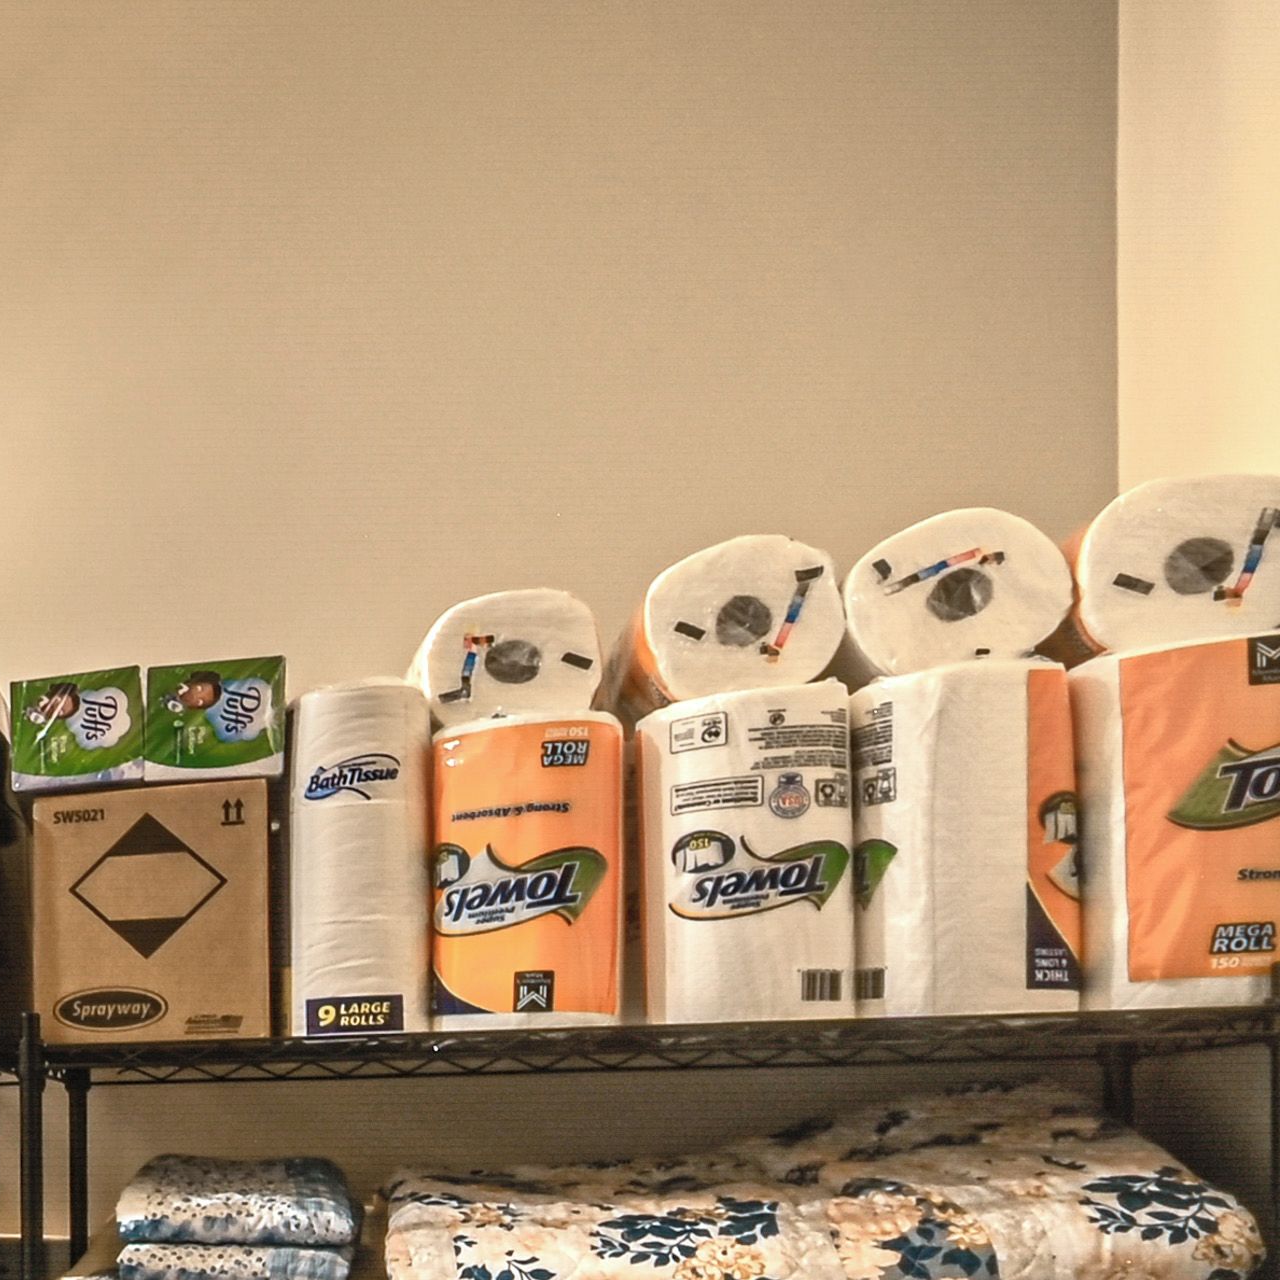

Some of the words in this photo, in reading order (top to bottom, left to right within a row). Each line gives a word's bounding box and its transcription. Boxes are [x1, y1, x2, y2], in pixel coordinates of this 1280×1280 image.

[220, 685, 261, 734] Puffs
[81, 695, 118, 741] Puffs
[543, 741, 588, 755] ROLL
[543, 753, 585, 766] MEGA
[527, 801, 571, 813] Strong
[53, 808, 106, 825] SW5021
[452, 808, 512, 822] Absorbent
[692, 855, 826, 908] Towels
[1237, 868, 1280, 881] Stron
[444, 861, 582, 923] Towels
[1216, 923, 1274, 938] MEGA
[1213, 937, 1273, 953] ROLL
[1210, 956, 1240, 969] 150
[1035, 970, 1069, 982] THICK
[72, 1000, 151, 1020] Sprayway
[318, 1004, 336, 1027] 9
[340, 1001, 391, 1014] LARGE
[340, 1014, 385, 1026] ROLLS
